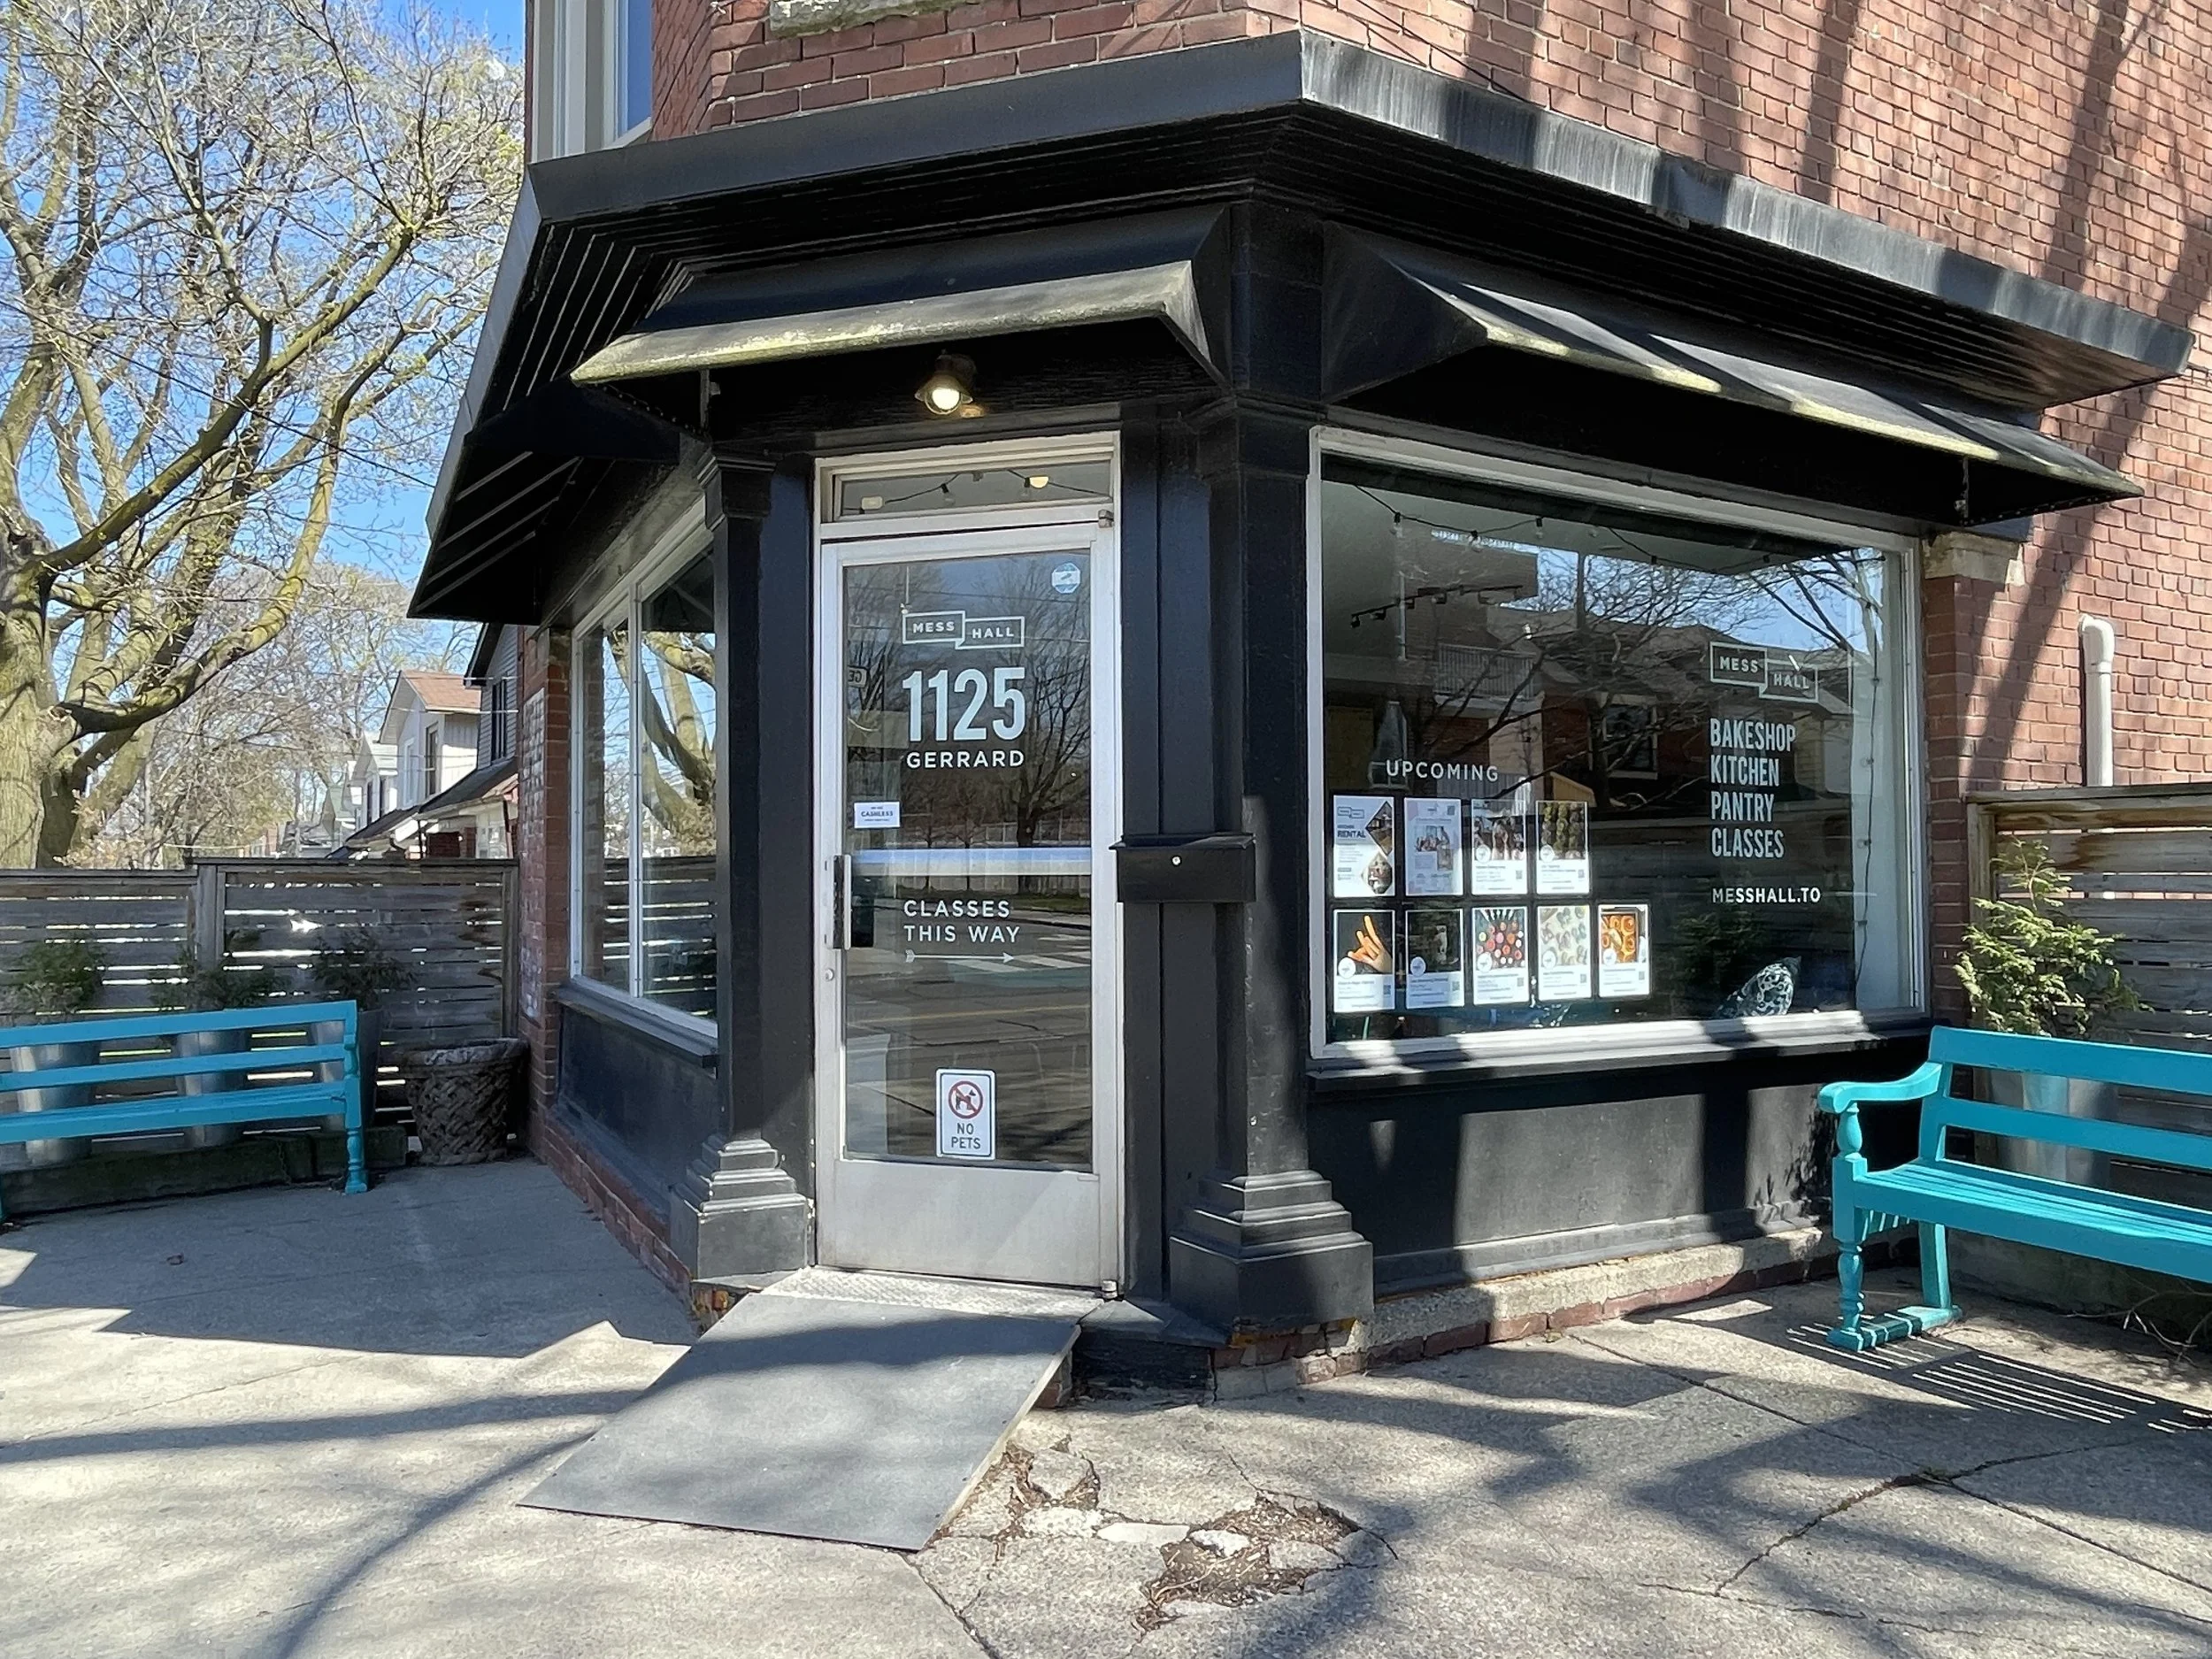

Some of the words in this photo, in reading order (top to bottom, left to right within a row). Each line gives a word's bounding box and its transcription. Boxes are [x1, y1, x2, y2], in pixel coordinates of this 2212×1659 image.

[912, 621, 955, 634] MESS
[972, 626, 1015, 639] HALL
[1719, 656, 1759, 673] MESS
[1773, 672, 1810, 689] HALL
[902, 666, 1026, 742] 1125
[1709, 718, 1796, 752] BAKESHOP
[906, 749, 1025, 769] GERRARD
[1386, 759, 1499, 782] UPCOMING
[1710, 755, 1780, 787] KITCHEN
[1710, 791, 1775, 822] PANTRY
[1711, 827, 1785, 858] CLASSES
[1712, 887, 1821, 903] MESSHALL.TO
[903, 899, 1010, 918] CLASSES
[903, 924, 956, 944] THIS
[968, 925, 1021, 944] WAY
[956, 1122, 974, 1135] NO
[950, 1136, 981, 1150] PETS
